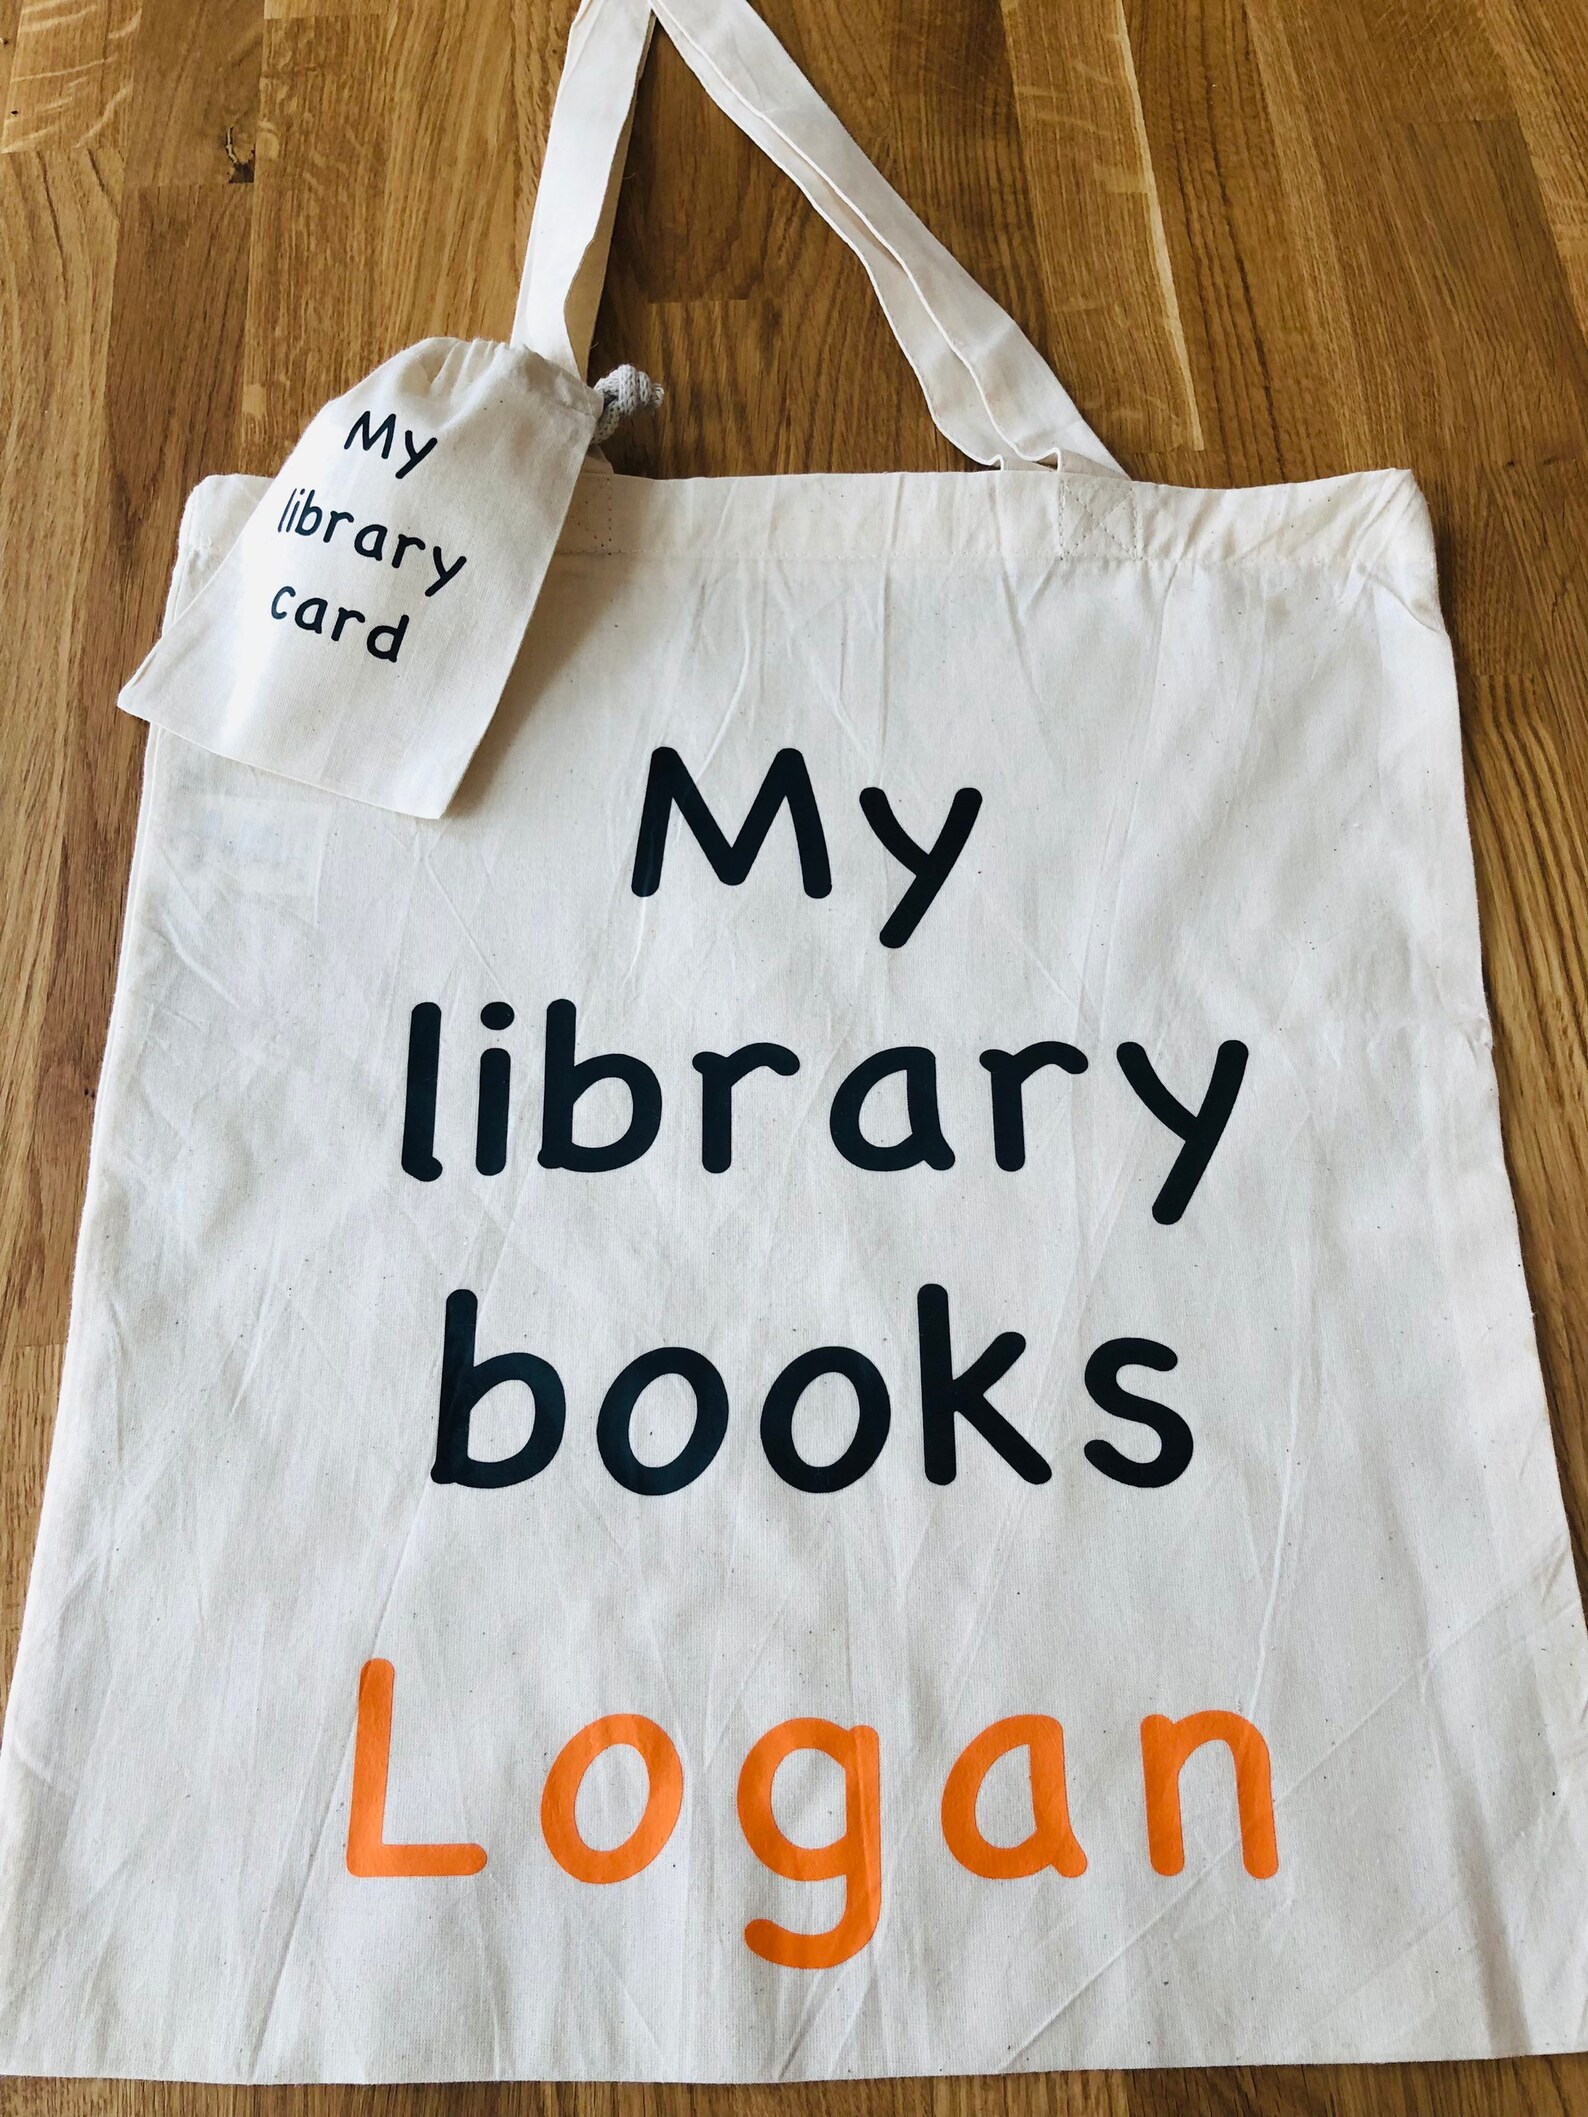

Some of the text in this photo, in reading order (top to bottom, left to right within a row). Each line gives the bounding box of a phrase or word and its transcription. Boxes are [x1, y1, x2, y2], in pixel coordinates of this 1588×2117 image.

[276, 488, 467, 598] library
[343, 410, 438, 480] My
[271, 585, 410, 663] card
[630, 746, 983, 950] My
[400, 998, 1249, 1226] library
[430, 1283, 1195, 1497] books
[346, 1658, 1279, 1970] Logan
